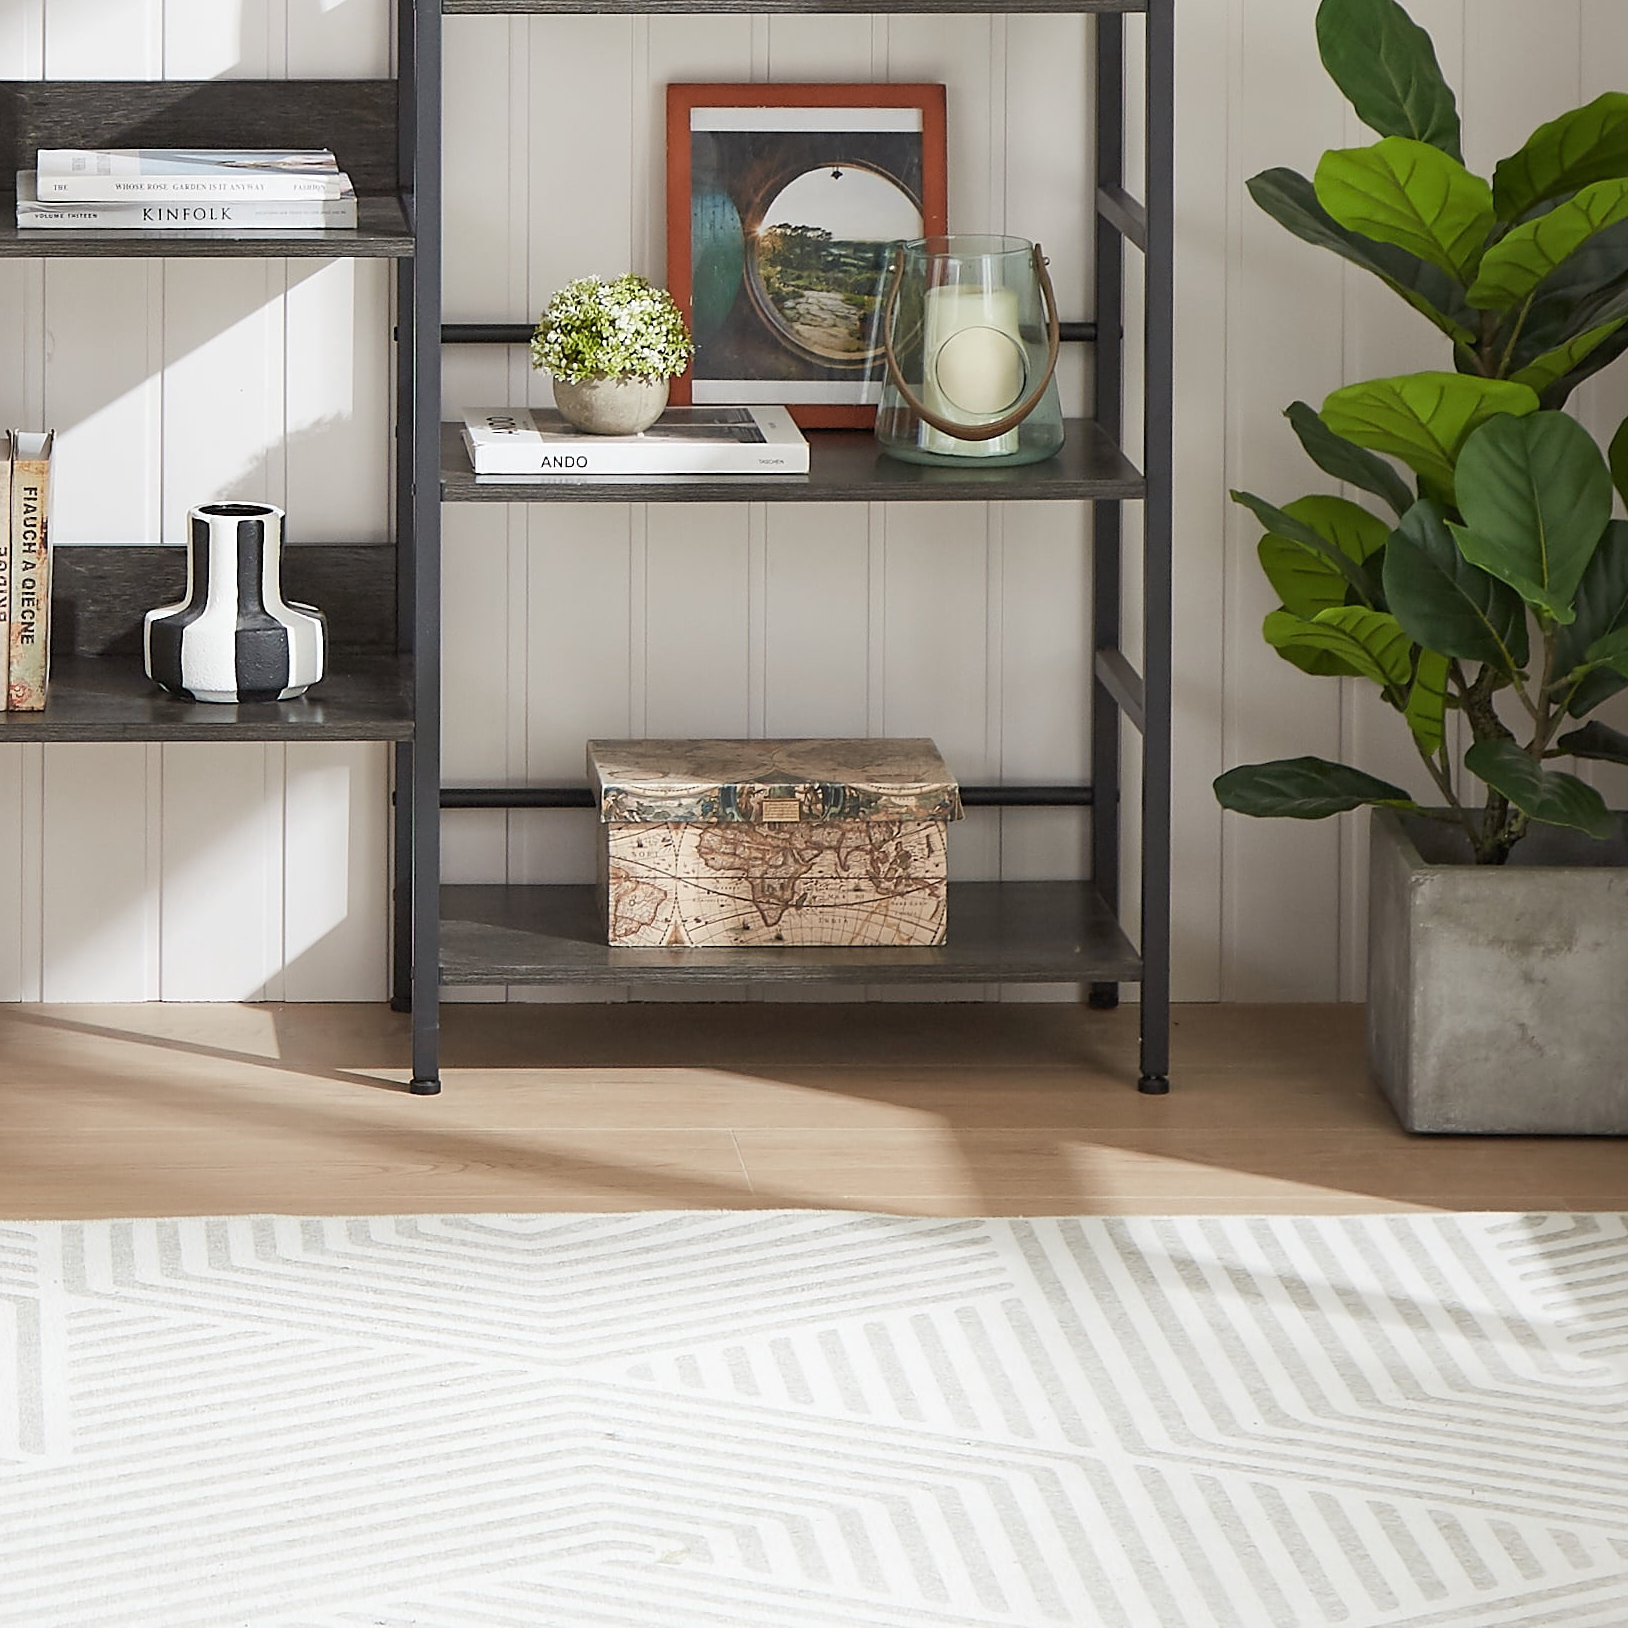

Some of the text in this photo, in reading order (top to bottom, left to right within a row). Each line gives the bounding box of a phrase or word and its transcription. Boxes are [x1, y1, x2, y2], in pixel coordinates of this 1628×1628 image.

[115, 183, 145, 191] WHOSE
[147, 183, 168, 191] ROSE
[172, 183, 207, 191] GARDEN
[227, 183, 265, 191] ANYWAY
[143, 207, 232, 221] KINFOLK
[540, 455, 588, 468] ANDO
[22, 560, 37, 572] A
